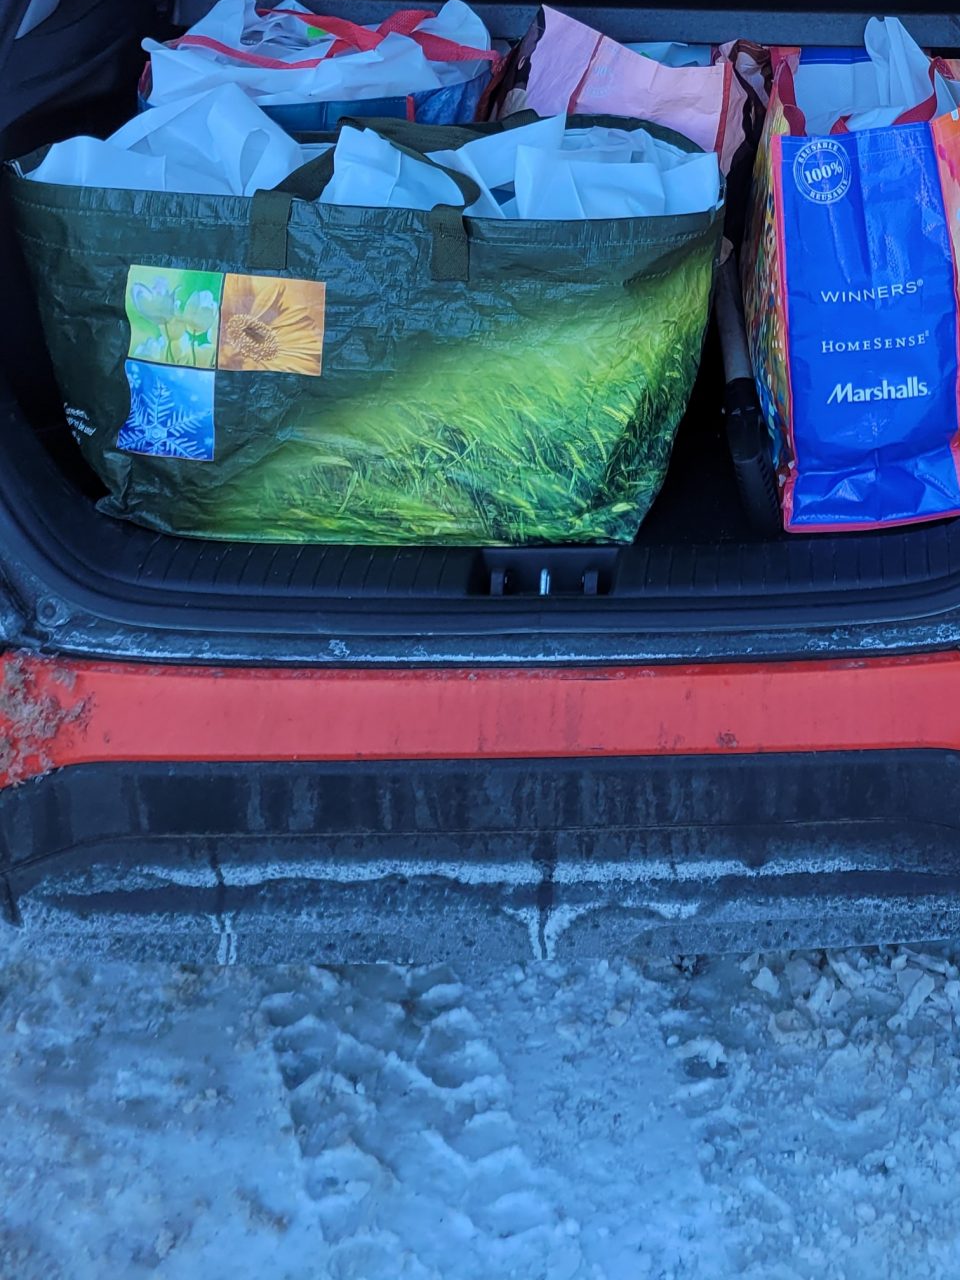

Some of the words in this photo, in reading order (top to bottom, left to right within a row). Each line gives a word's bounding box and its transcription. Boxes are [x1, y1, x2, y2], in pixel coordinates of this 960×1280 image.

[798, 141, 838, 164] REUSABLE
[804, 159, 843, 184] 100%
[809, 178, 848, 201] REUSABLE
